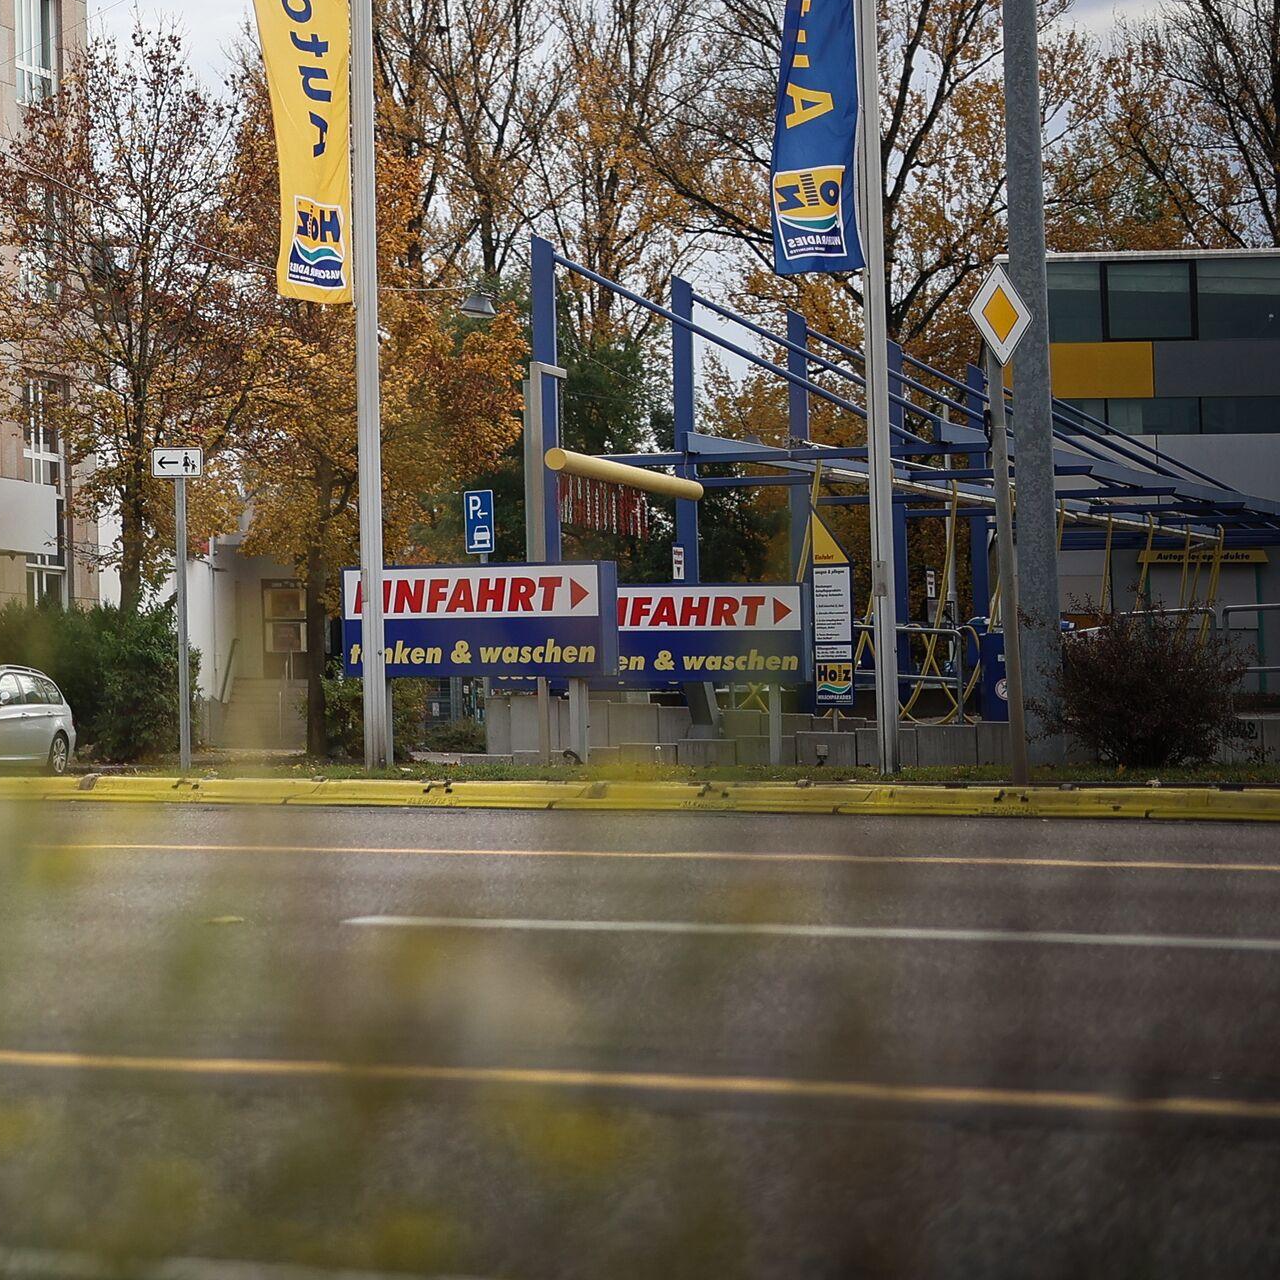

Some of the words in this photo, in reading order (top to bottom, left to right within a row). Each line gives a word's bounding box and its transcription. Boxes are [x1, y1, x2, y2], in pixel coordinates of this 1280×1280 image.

[469, 496, 482, 520] P
[450, 640, 472, 664] &
[479, 638, 596, 664] waschen
[653, 649, 675, 670] &
[683, 648, 799, 671] waschen
